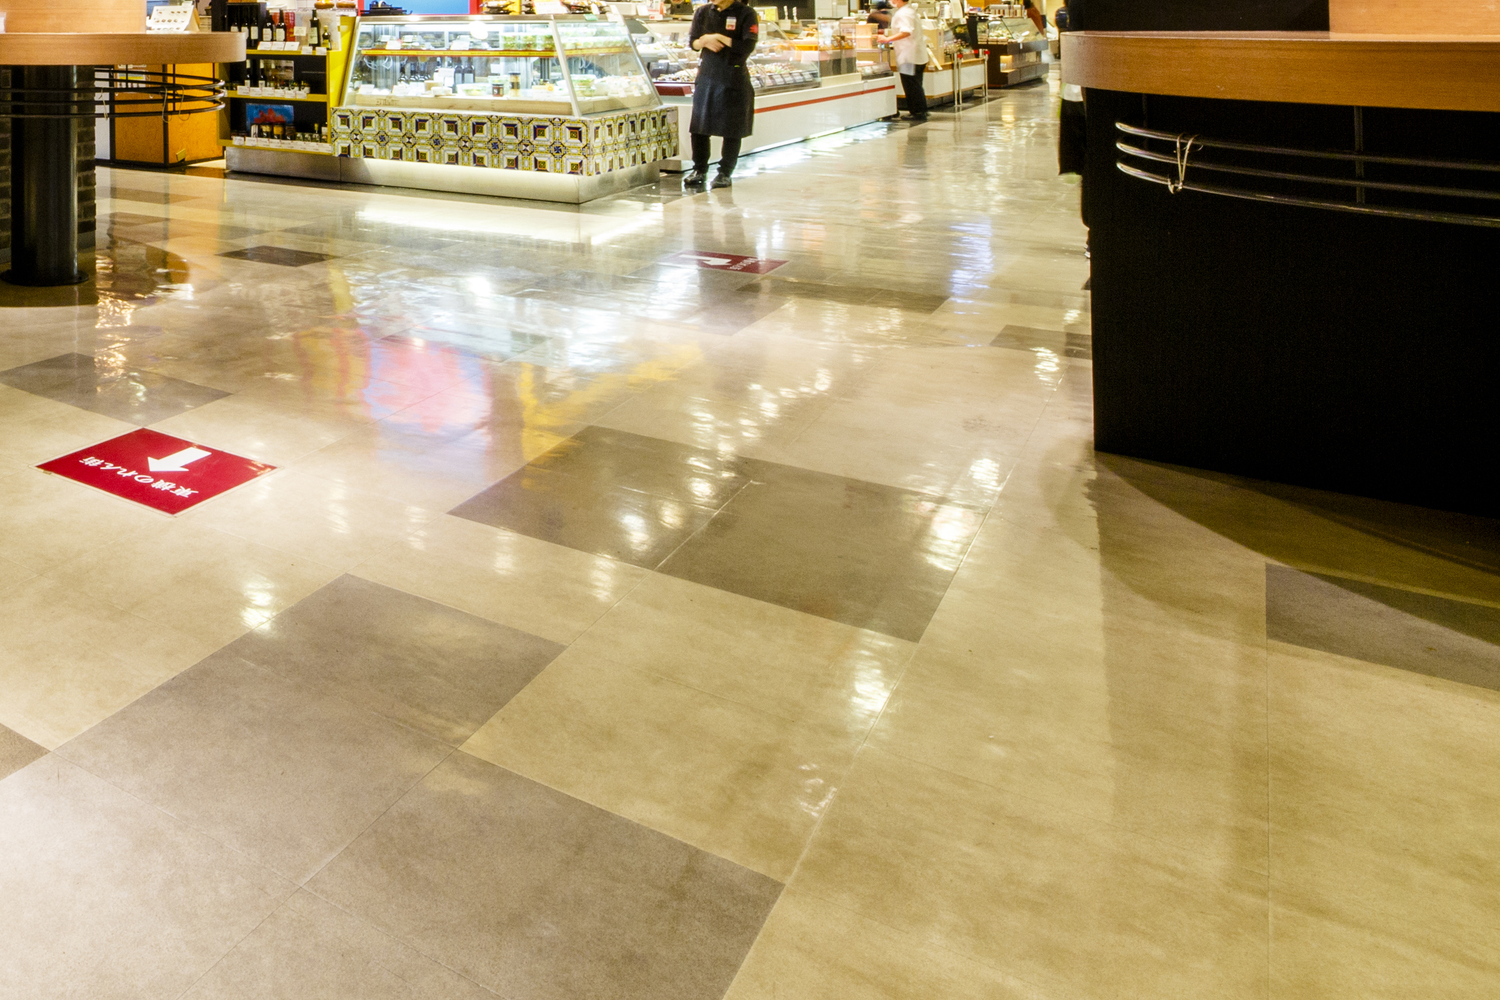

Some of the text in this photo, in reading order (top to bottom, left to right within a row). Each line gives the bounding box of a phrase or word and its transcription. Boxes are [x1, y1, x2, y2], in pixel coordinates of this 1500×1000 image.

[78, 455, 200, 499] 東横のれん街
